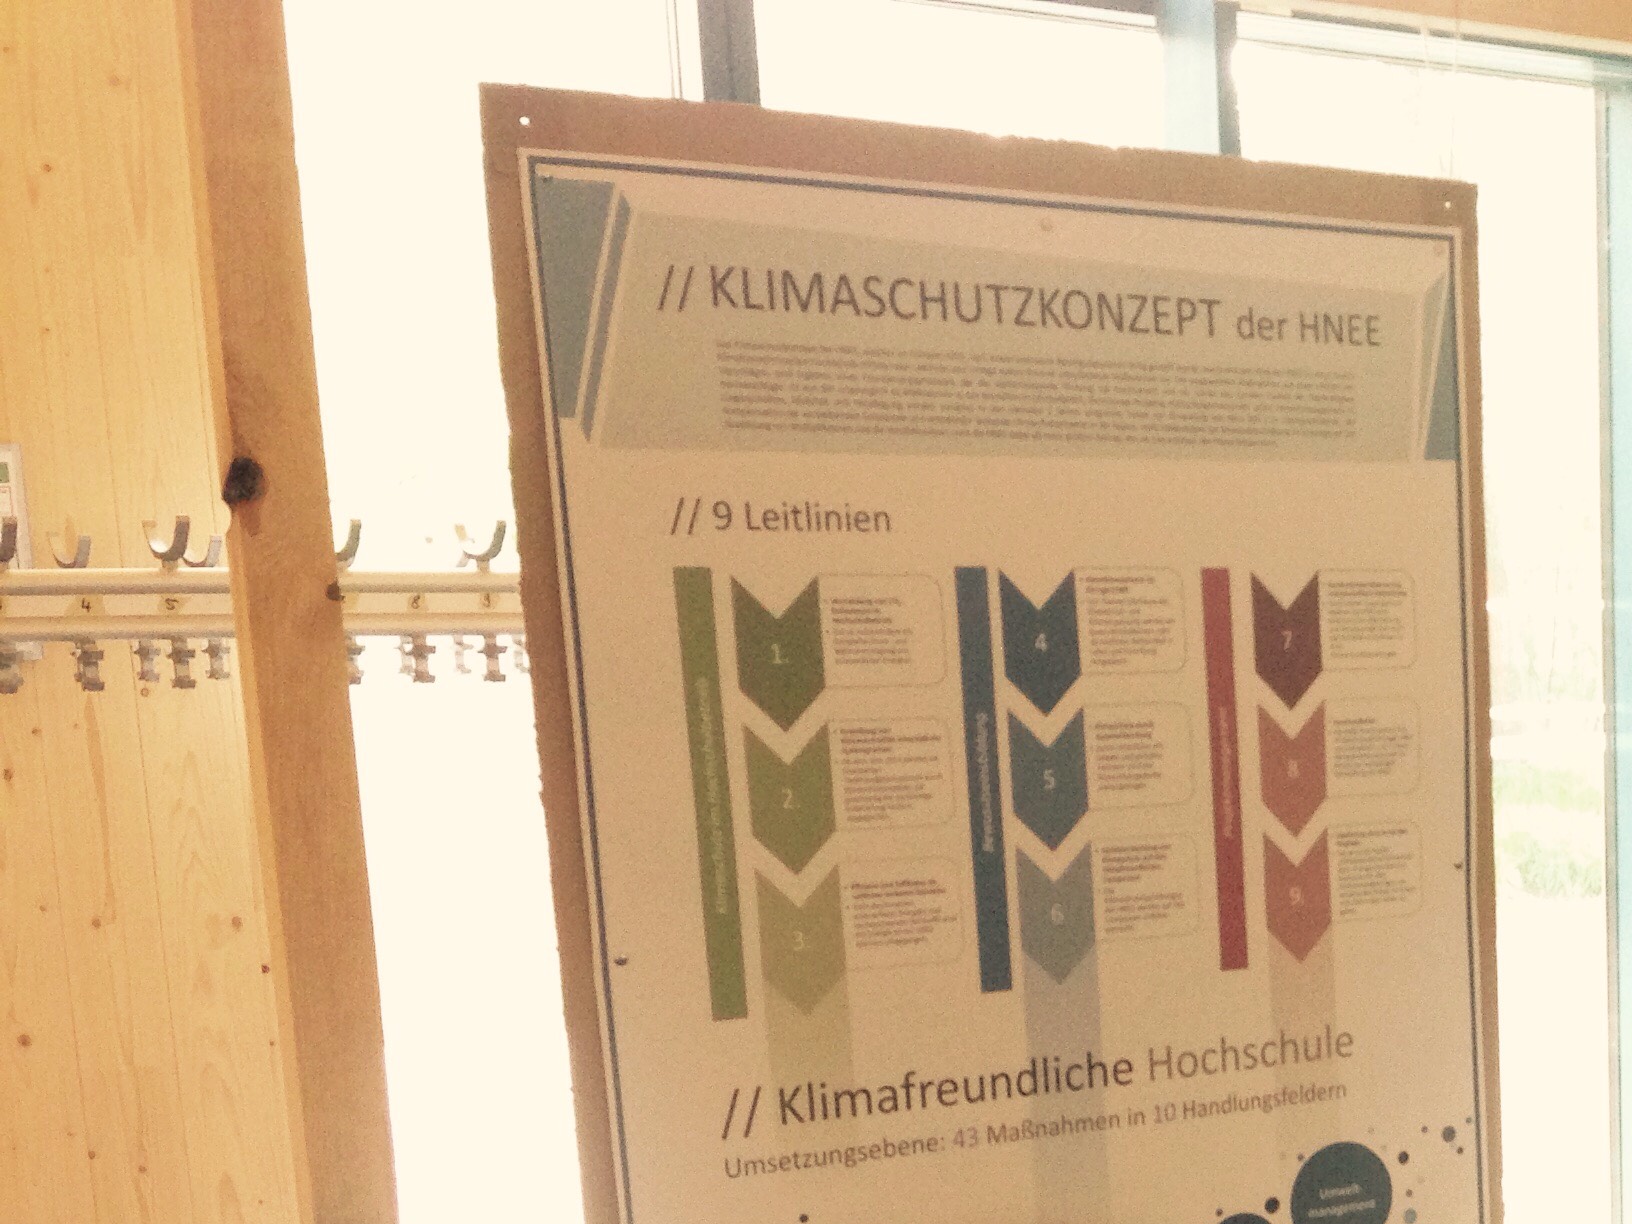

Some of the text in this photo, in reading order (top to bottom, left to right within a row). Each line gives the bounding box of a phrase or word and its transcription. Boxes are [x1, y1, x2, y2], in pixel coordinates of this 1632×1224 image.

[709, 263, 1221, 339] KLIMASCHUTZKONZEPT
[1236, 307, 1288, 343] der
[1299, 312, 1382, 348] HNEE
[712, 501, 733, 532] 9
[743, 500, 892, 535] Leitlinien
[81, 597, 92, 613] 4
[778, 1051, 1134, 1126] Klimafreundliche
[1148, 1024, 1355, 1082] Hochschule
[723, 1081, 1347, 1179] Umsetzungsebene: 43 Maßnahmen in 10 Handlungsfeldern
